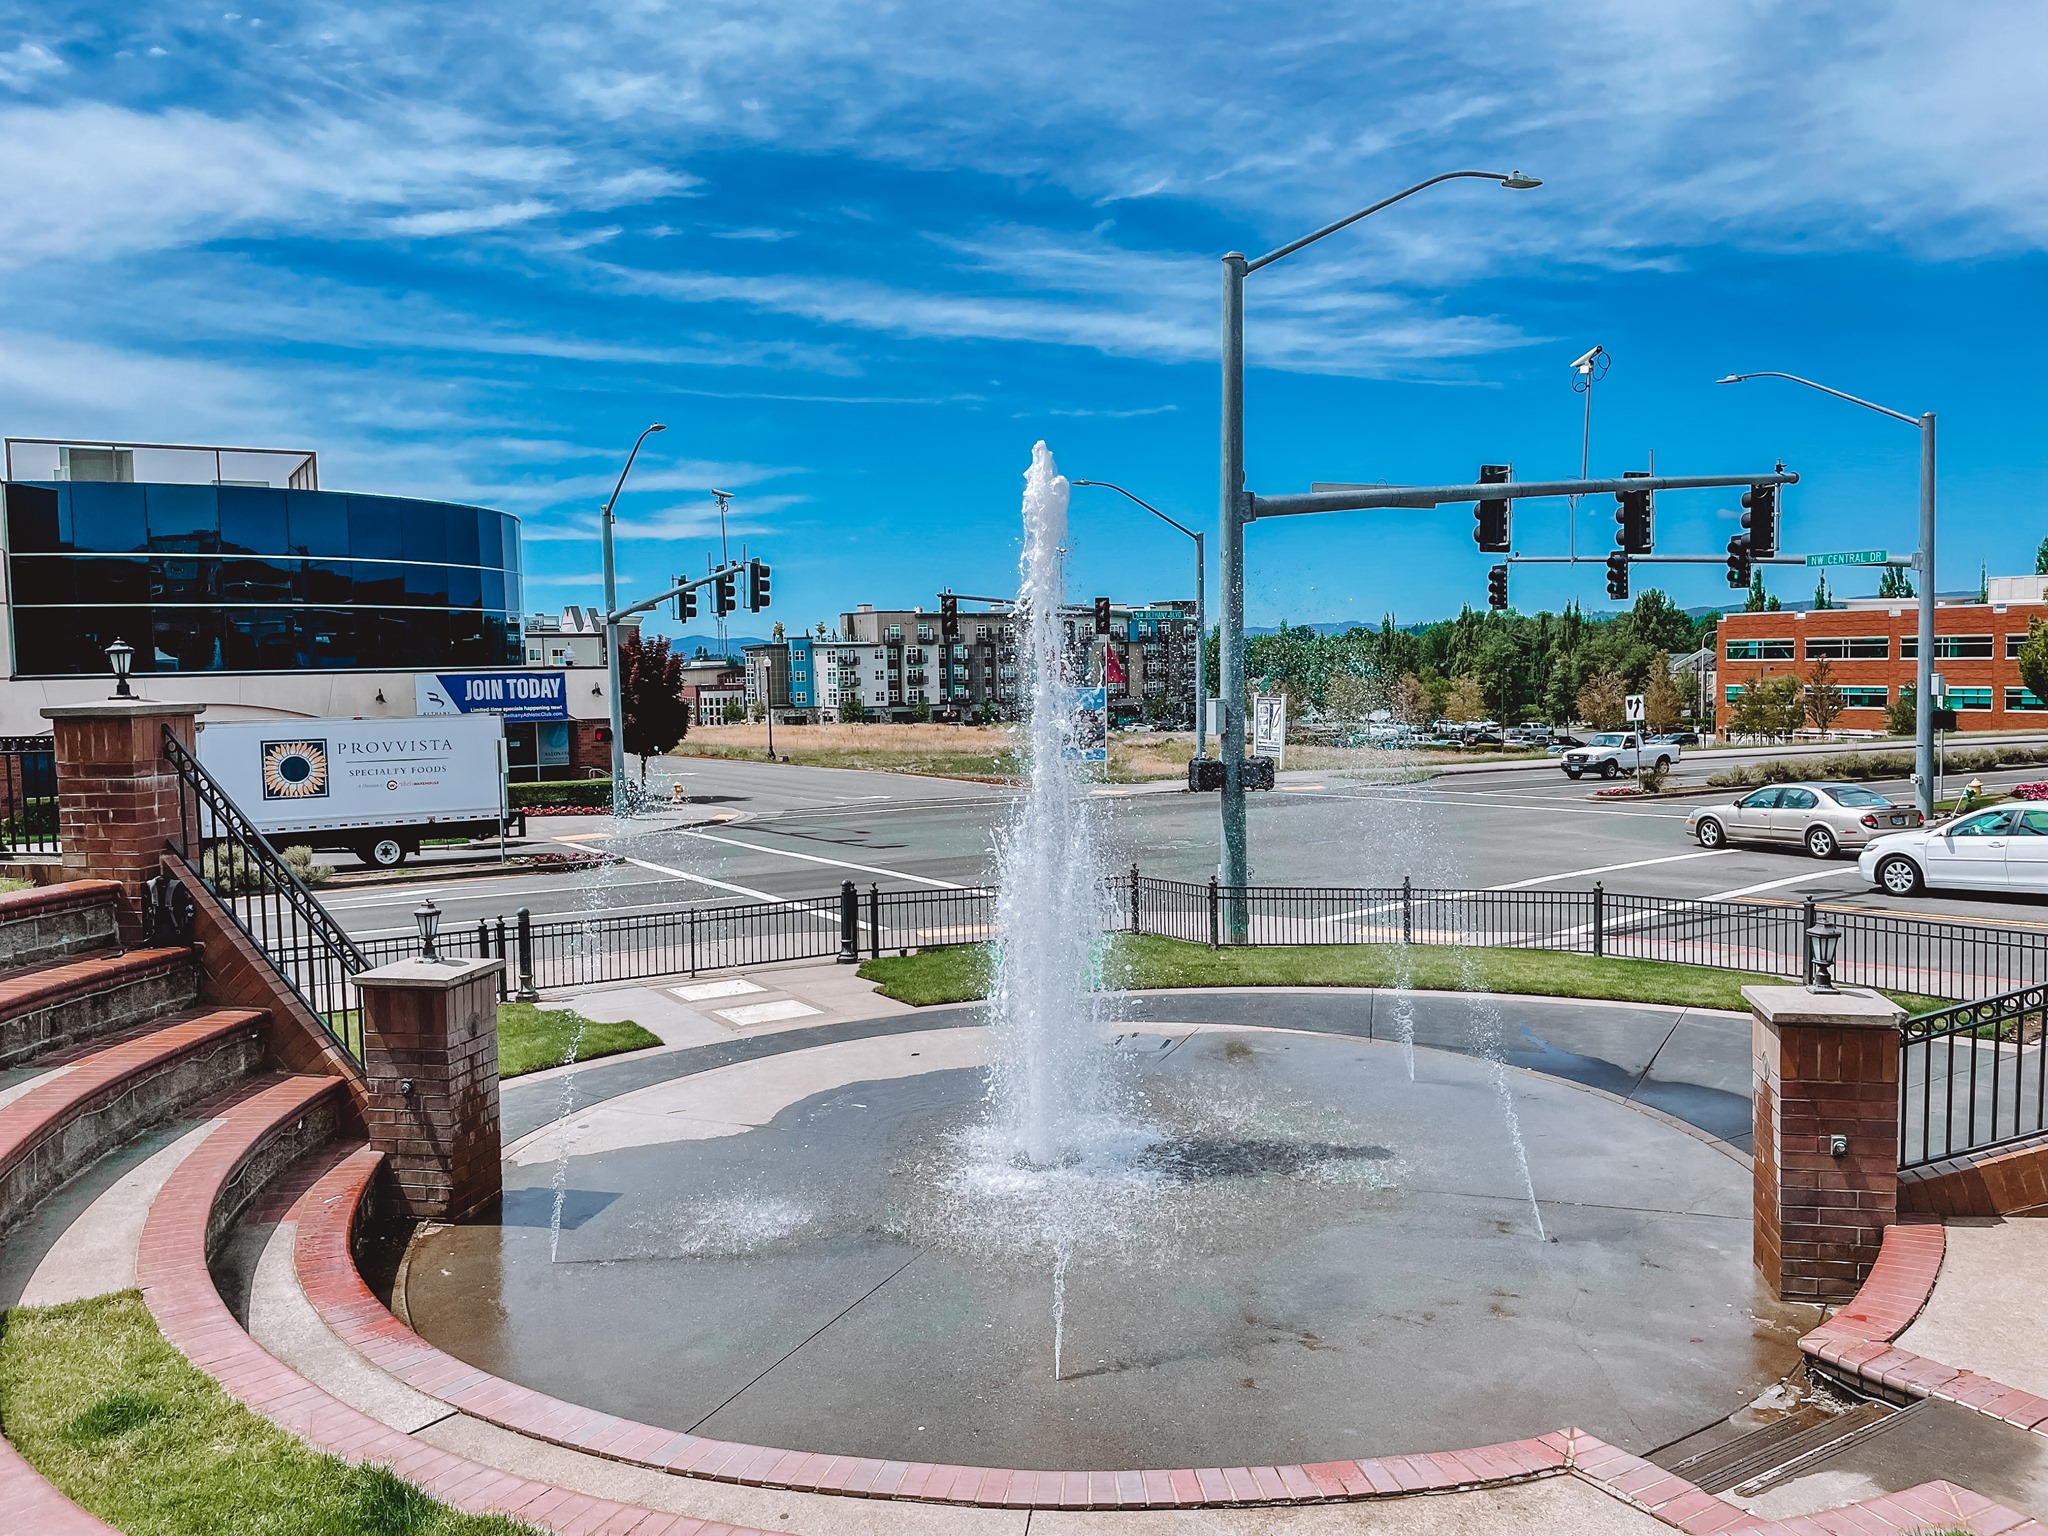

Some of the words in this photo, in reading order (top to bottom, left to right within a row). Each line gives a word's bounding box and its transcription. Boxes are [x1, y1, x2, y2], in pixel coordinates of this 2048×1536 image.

[1811, 555, 1824, 566] NW
[1827, 553, 1866, 565] CENTRAL
[1870, 552, 1882, 562] DR
[465, 679, 503, 701] JOIN
[506, 678, 561, 700] TODAY
[337, 739, 453, 754] PROVVISTA
[349, 766, 407, 777] SPECIALTY
[411, 765, 447, 774] FOODS
